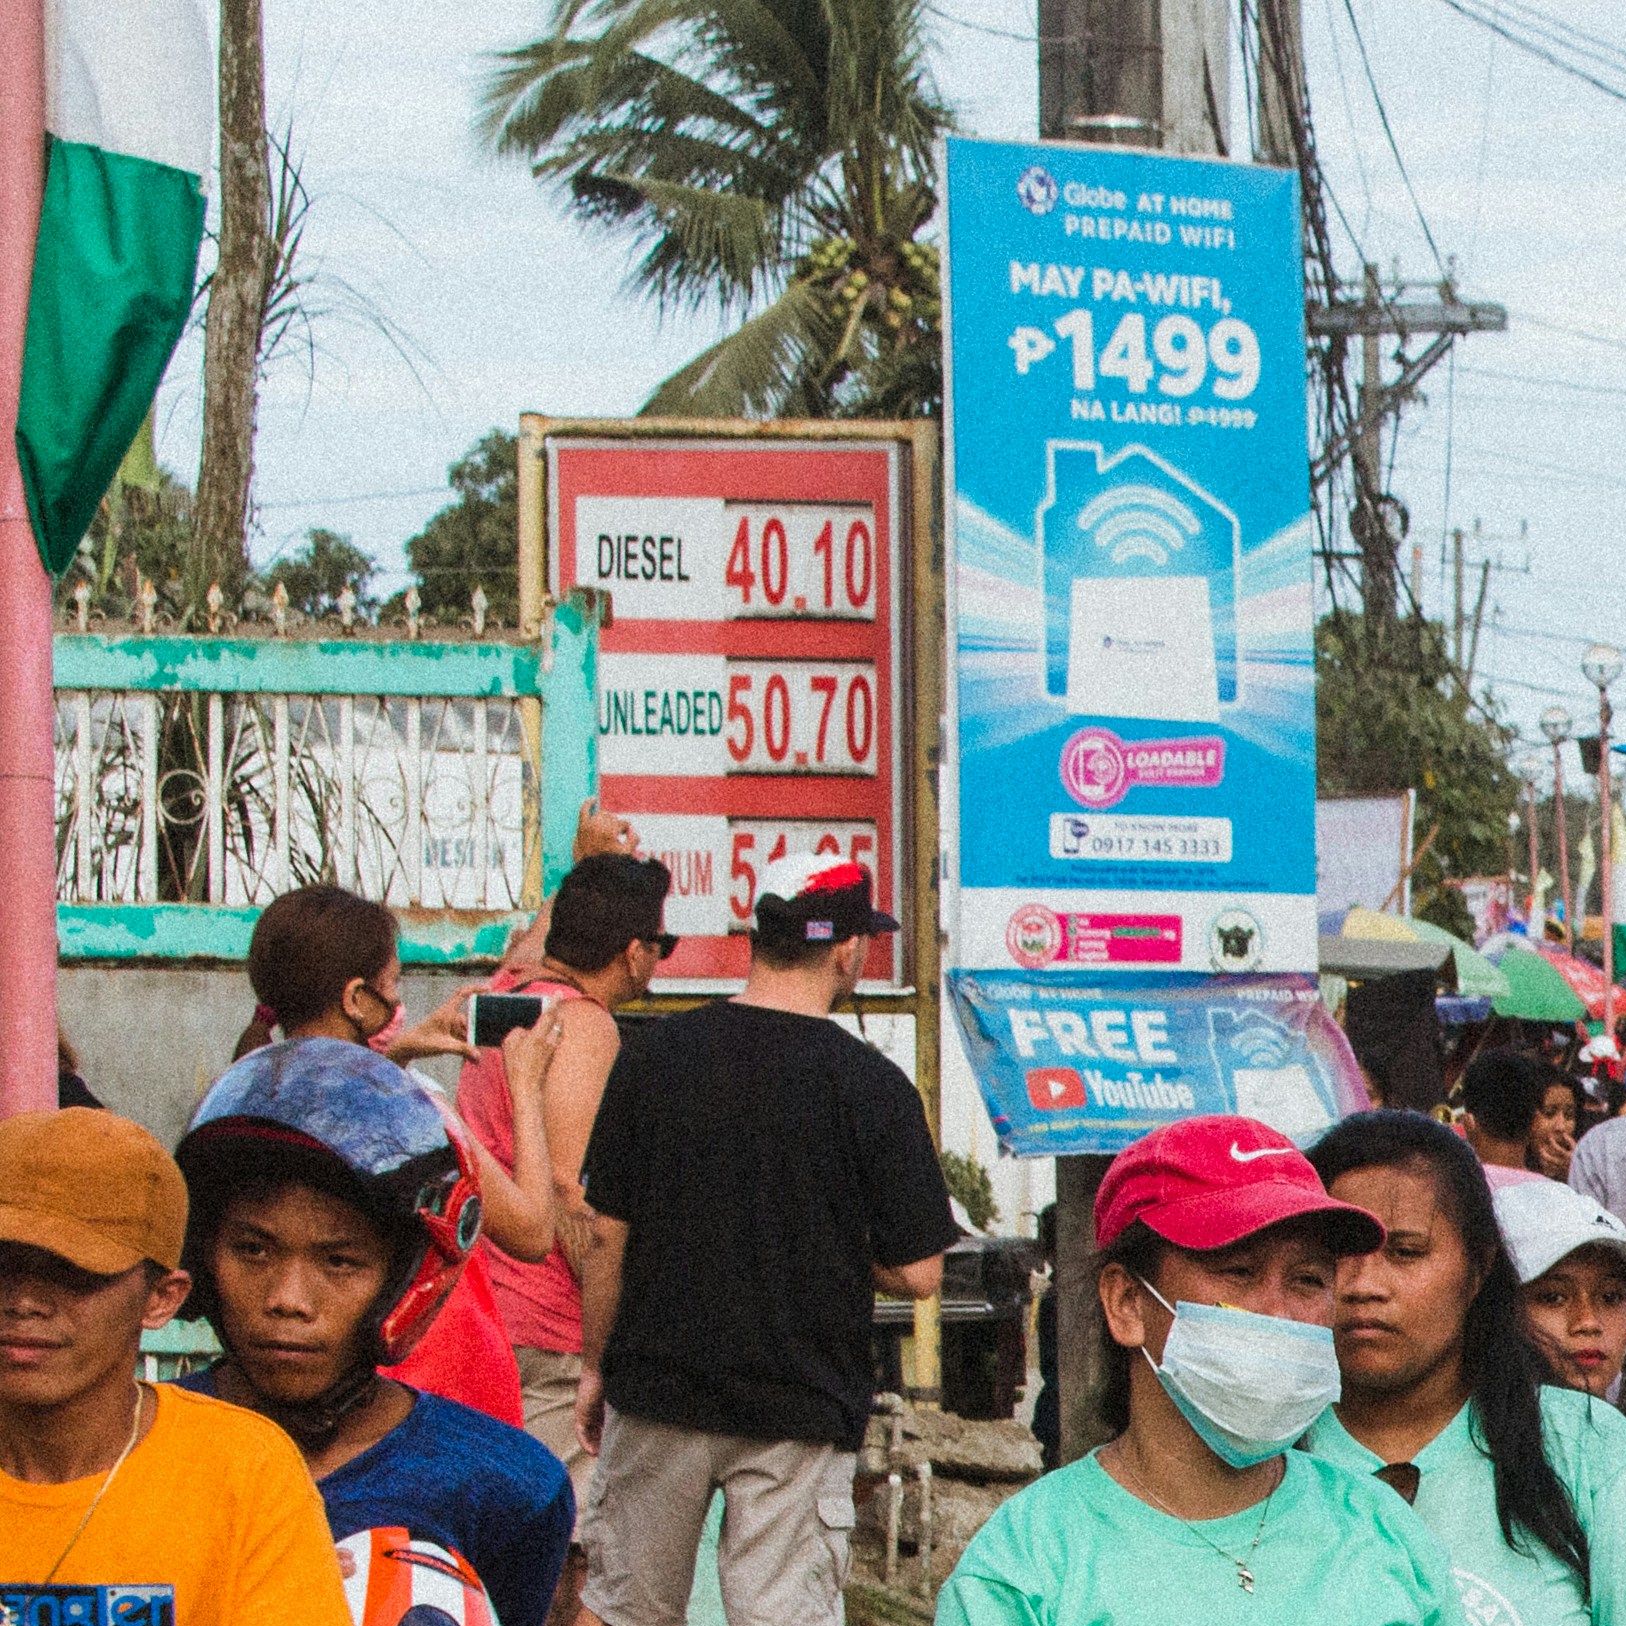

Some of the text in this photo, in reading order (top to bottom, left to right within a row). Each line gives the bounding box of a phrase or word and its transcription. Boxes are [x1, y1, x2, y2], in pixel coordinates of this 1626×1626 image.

[1063, 181, 1234, 220] Globe AT HOME
[1065, 214, 1236, 250] PREPAID WIFI
[1010, 260, 1232, 315] MAY PA-WIFI,
[1070, 398, 1107, 421] NA
[1110, 400, 1182, 426] LANG!
[597, 516, 873, 612] DIESEL 40.10
[599, 673, 872, 766] UNLEADED 50.70
[1127, 750, 1216, 769] LOADABLE
[1092, 837, 1220, 856] 0917 145 3333
[1008, 1008, 1178, 1063] FREE
[1084, 1069, 1195, 1110] YouTube
